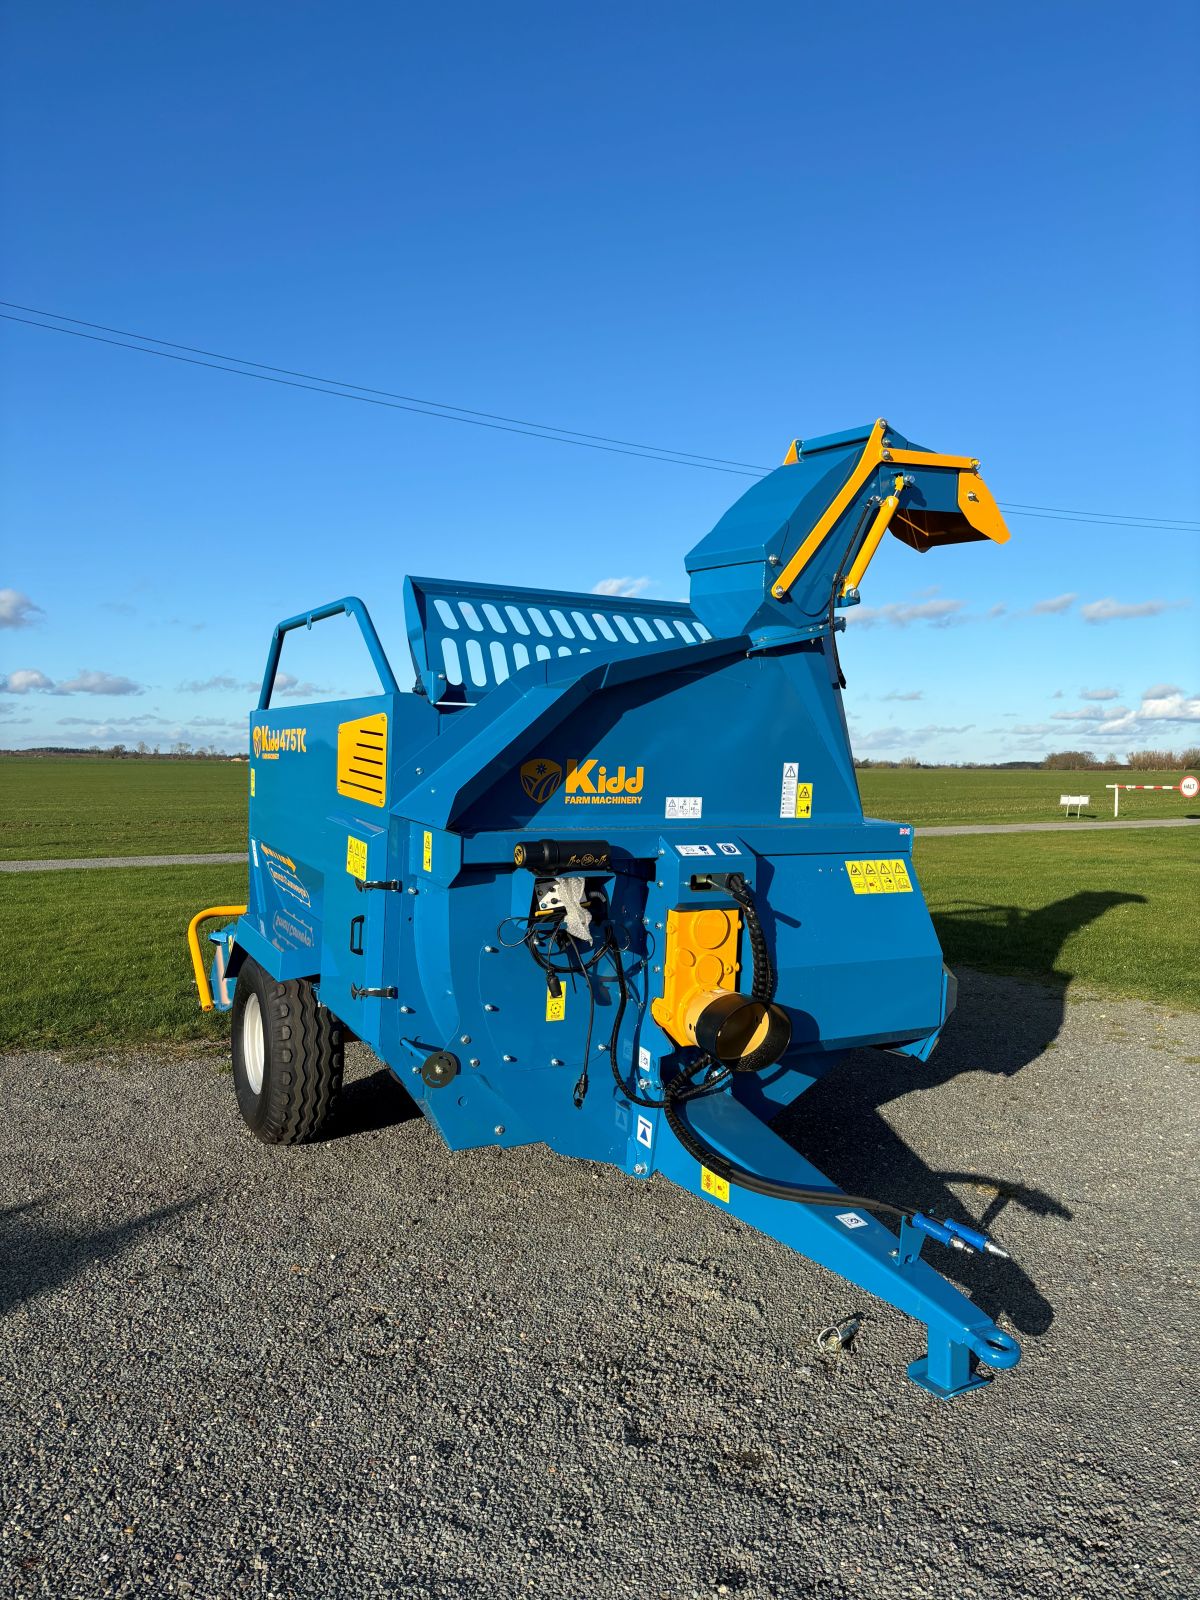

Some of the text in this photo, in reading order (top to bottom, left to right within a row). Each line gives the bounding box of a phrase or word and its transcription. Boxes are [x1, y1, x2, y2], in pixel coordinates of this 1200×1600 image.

[262, 725, 306, 752] Kidd 475TC
[565, 759, 644, 793] Kidd
[565, 796, 642, 804] FARM MACHINERY
